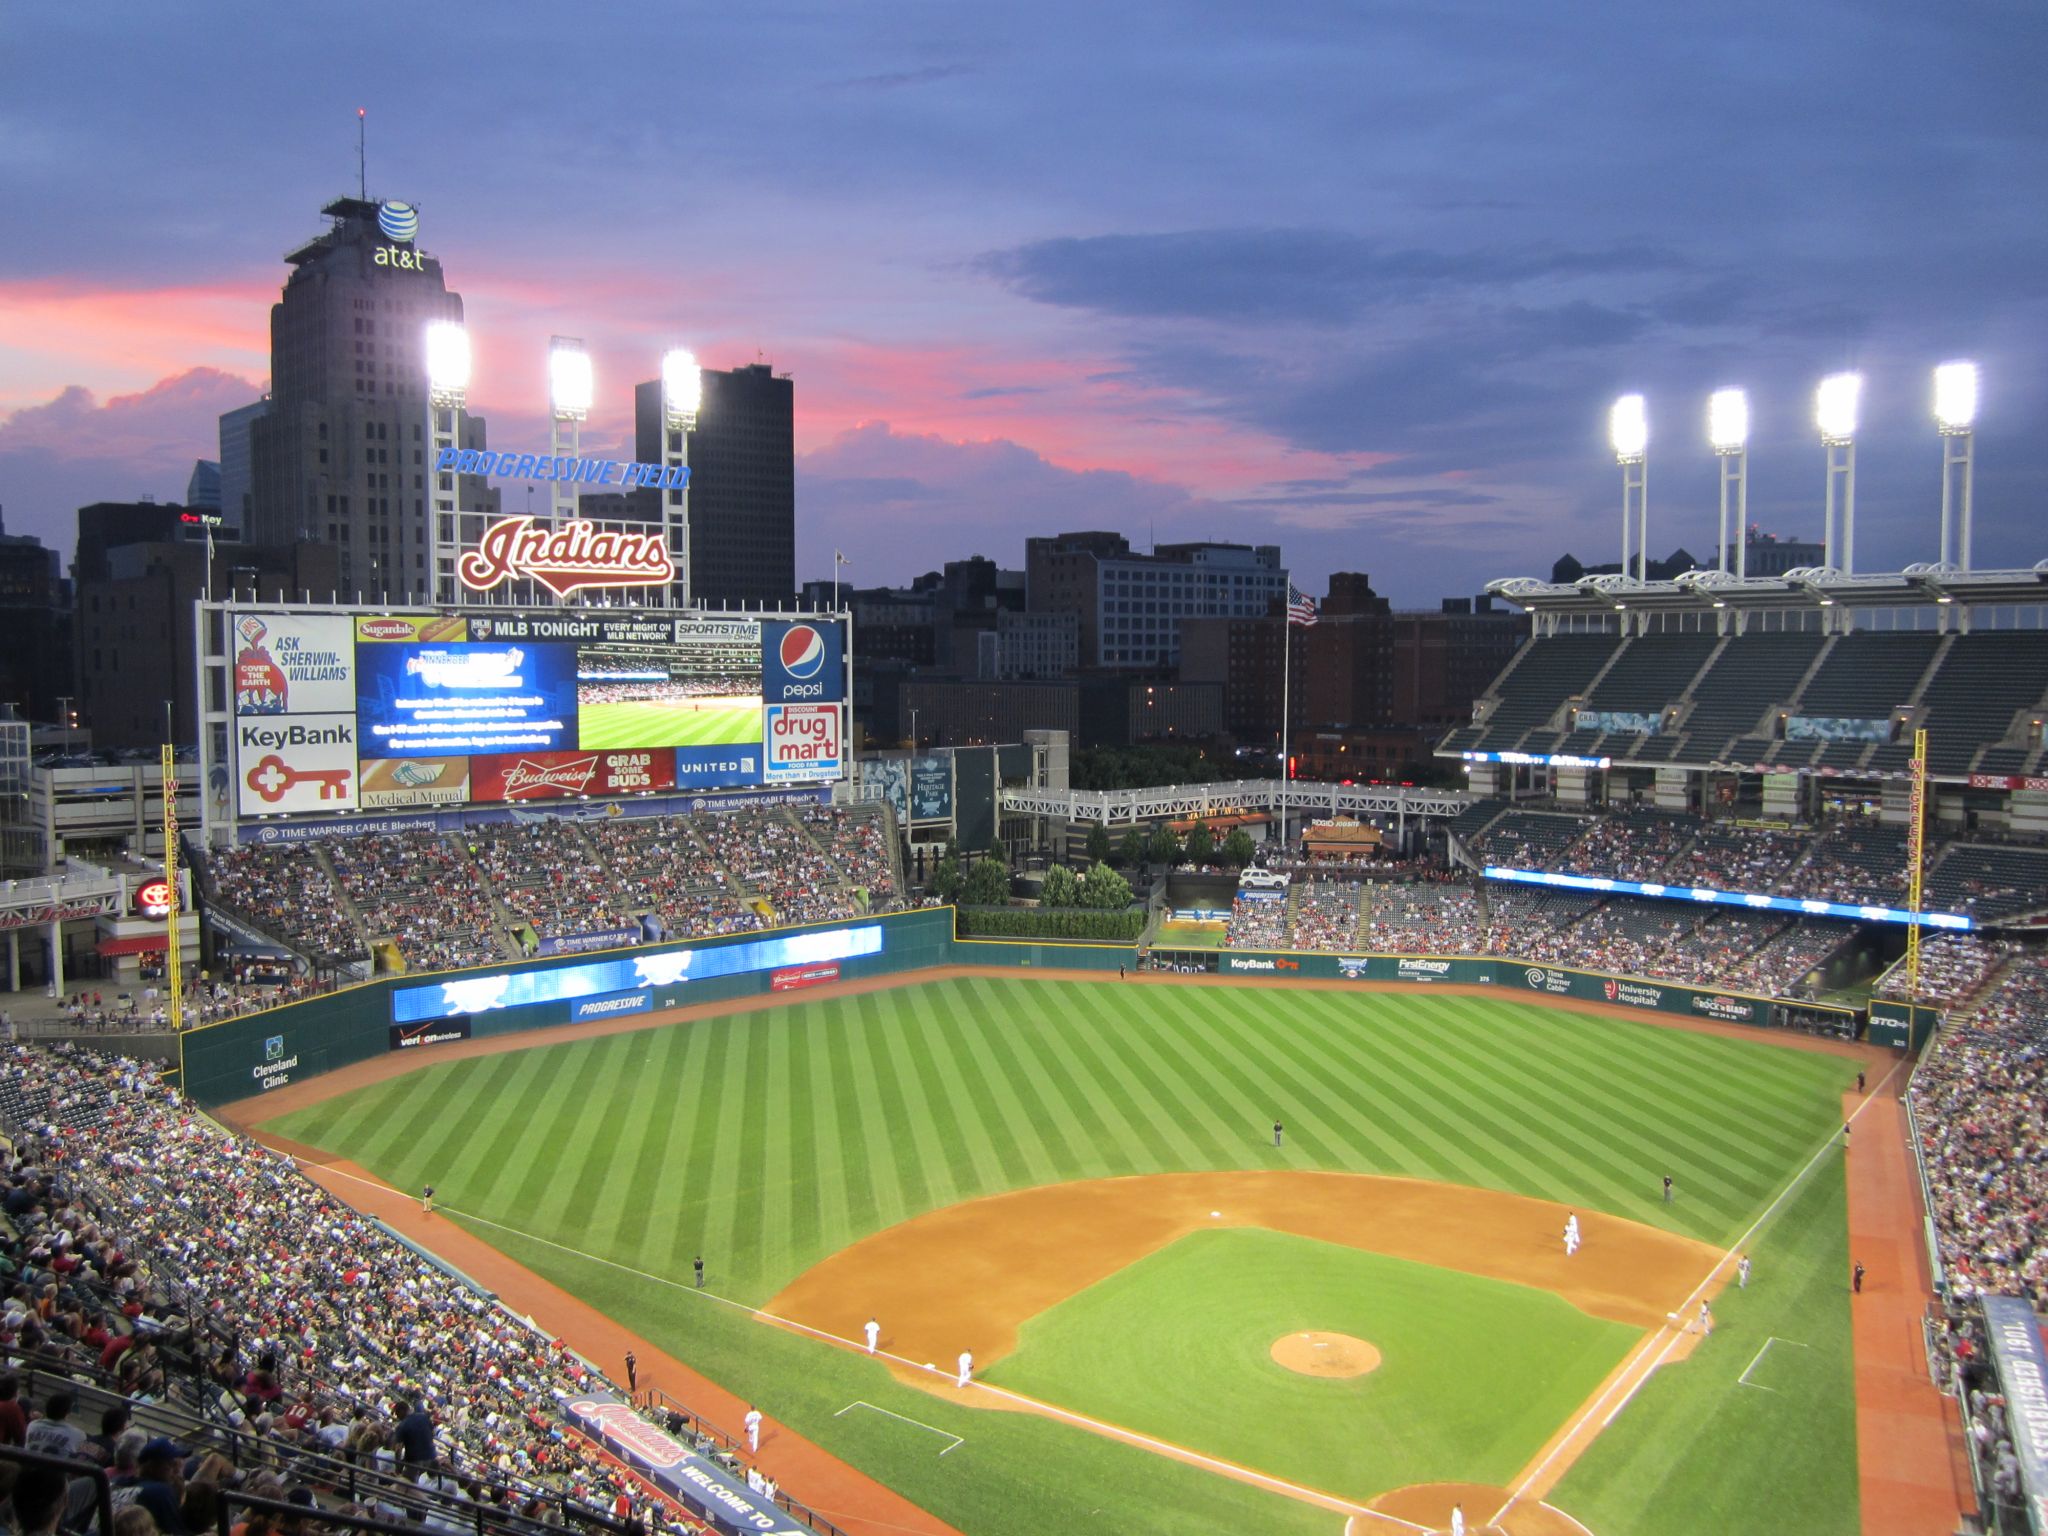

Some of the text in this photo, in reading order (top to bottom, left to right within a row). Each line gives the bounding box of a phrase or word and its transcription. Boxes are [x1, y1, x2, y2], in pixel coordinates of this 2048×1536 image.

[374, 244, 424, 272] at&t
[436, 447, 692, 489] PROGRESSIVE FIELD
[202, 514, 222, 525] Key
[458, 515, 675, 592] Indians
[362, 622, 415, 638] Sugardale
[495, 621, 600, 637] MLB TONIGHT
[603, 622, 671, 632] EVERY NIGHT ON
[678, 623, 759, 635] SPORTSTIME
[275, 636, 300, 651] ASK
[607, 631, 667, 641] MLB NETWORK
[280, 651, 341, 667] SHERWIN-
[241, 664, 271, 673] COVER
[289, 667, 347, 682] WILLIAMS
[783, 680, 823, 699] pepsi
[774, 712, 827, 741] drug
[242, 724, 353, 750] KeyBank
[779, 738, 834, 761] mart
[606, 754, 651, 768] GRAB
[682, 762, 737, 774] UNITED
[502, 766, 596, 787] Budweiser
[614, 766, 643, 775] SOME
[766, 772, 784, 780] More
[785, 771, 800, 779] than
[808, 769, 841, 779] Drugstore
[607, 774, 651, 788] BUDS
[367, 788, 464, 806] Medical Mutual
[707, 798, 726, 809] TIME
[727, 796, 759, 807] WARNER
[760, 795, 784, 805] CABLE
[1908, 758, 1922, 859] WALGREENS
[280, 820, 436, 838] TIME WARNER CABLE Bleachers
[582, 936, 607, 944] WARNER
[1231, 958, 1275, 970] KeyBank
[1399, 958, 1450, 972] FirstEnergy
[1547, 970, 1564, 979] Time
[1547, 976, 1571, 987] Warner
[1546, 983, 1567, 993] Cable
[1617, 983, 1662, 999] University
[579, 995, 646, 1016] PROGRESSIVE
[1617, 993, 1657, 1007] Hospitals
[1870, 1016, 1898, 1027] STO
[253, 1055, 298, 1079] Cleveland
[263, 1073, 289, 1090] Clinic
[289, 1405, 308, 1418] 10
[681, 1465, 775, 1529] WELCOME TO
